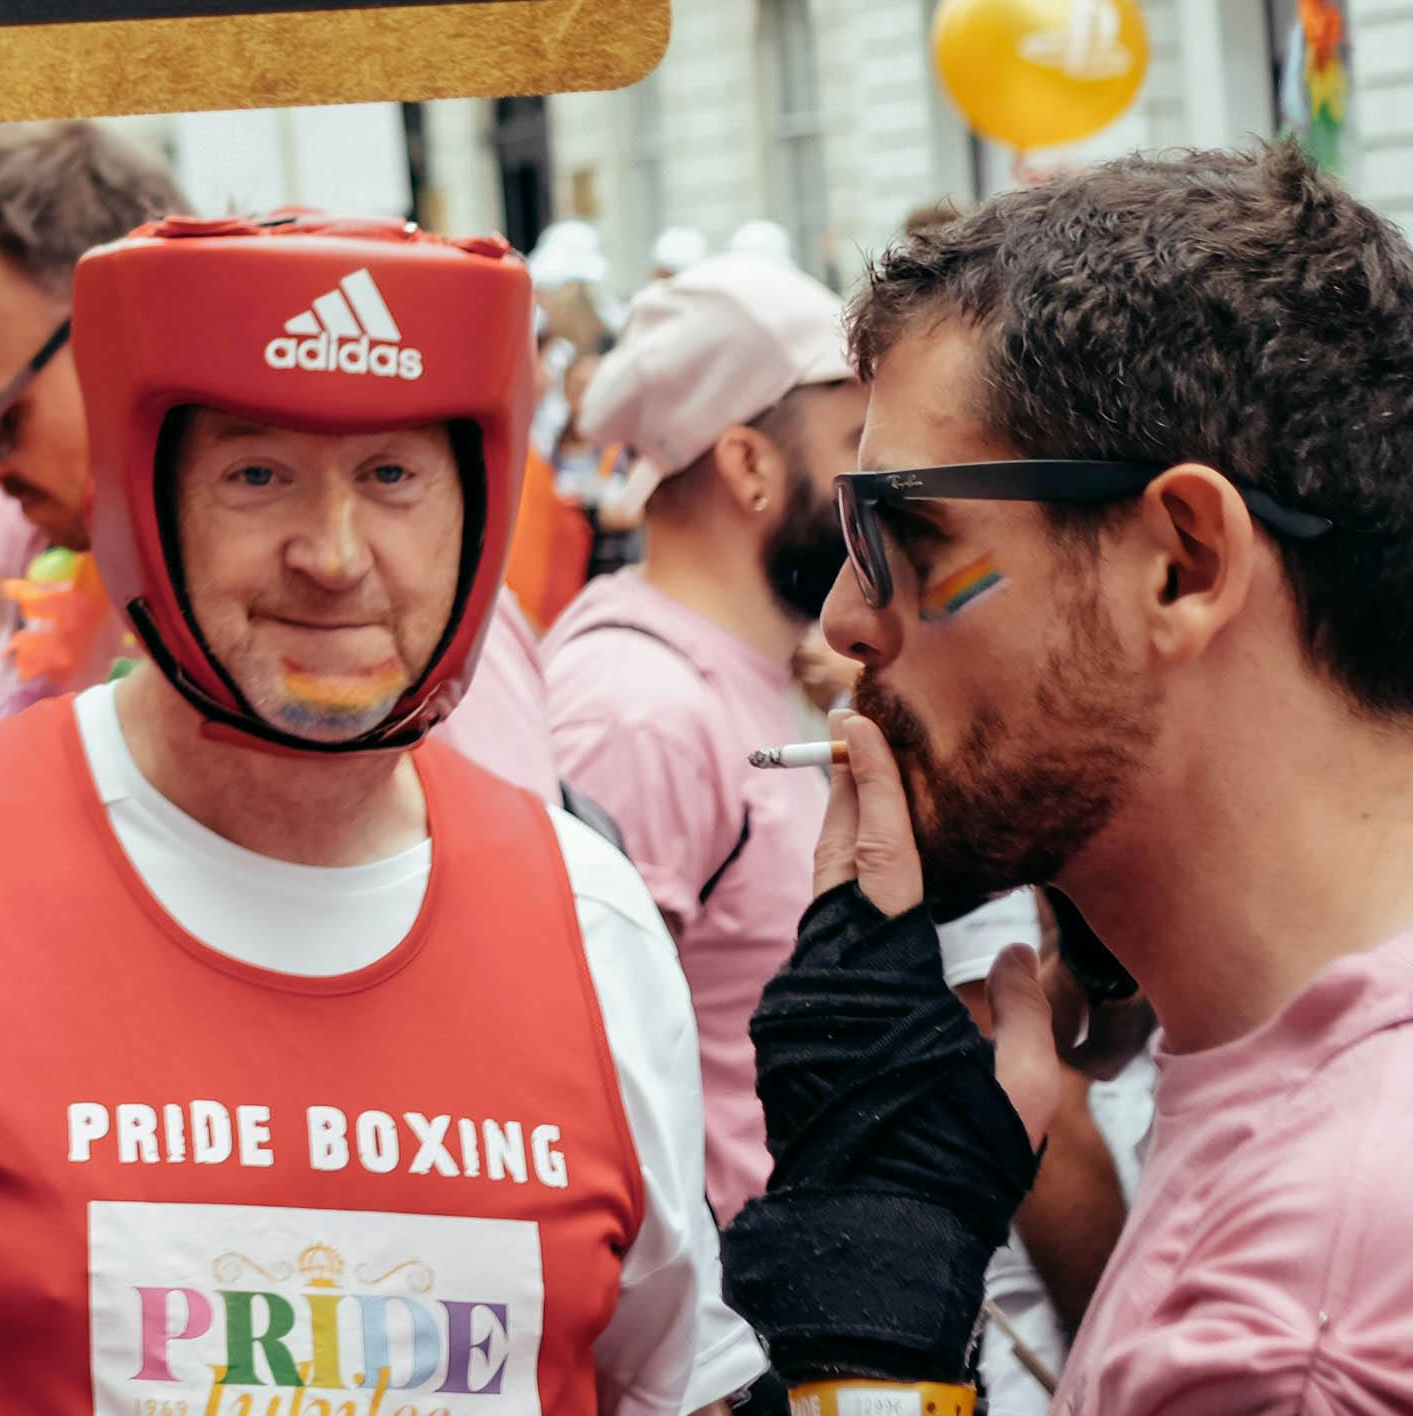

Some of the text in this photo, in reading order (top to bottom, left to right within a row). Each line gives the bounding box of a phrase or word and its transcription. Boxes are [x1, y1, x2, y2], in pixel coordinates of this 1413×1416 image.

[264, 332, 423, 379] adidas
[67, 1099, 569, 1188] PRIDE BOXING
[128, 1286, 509, 1395] PRIDE
